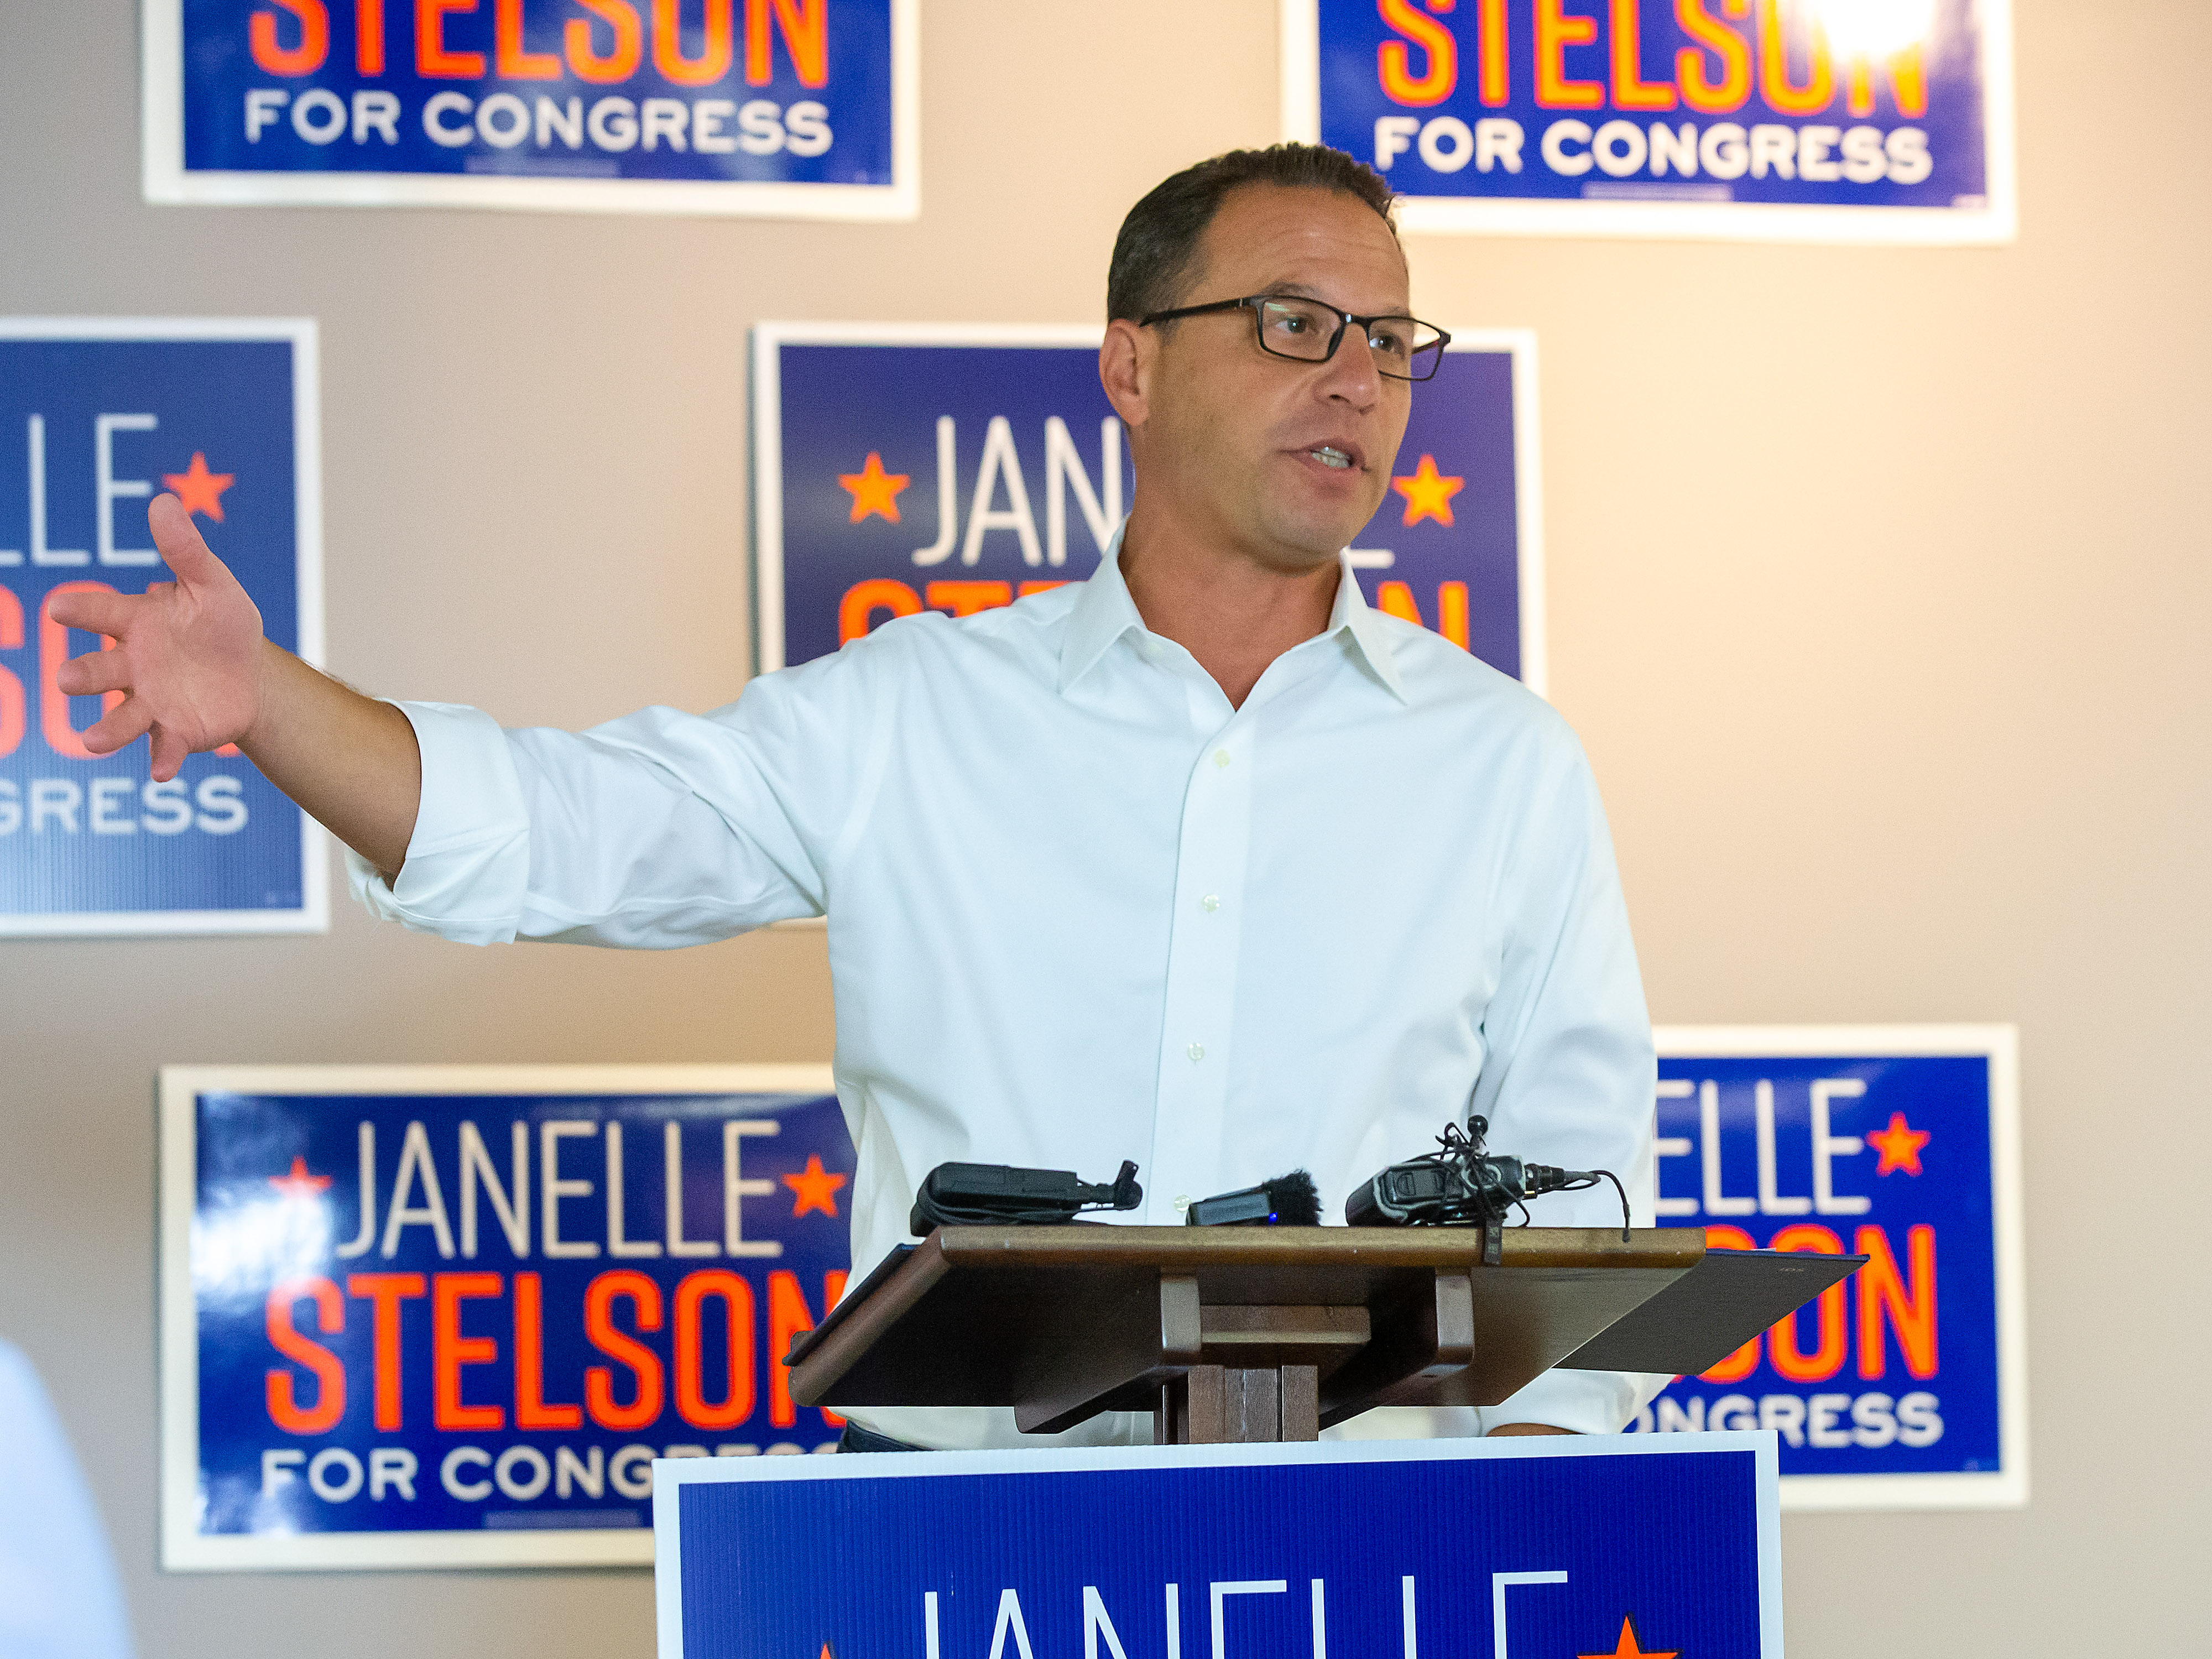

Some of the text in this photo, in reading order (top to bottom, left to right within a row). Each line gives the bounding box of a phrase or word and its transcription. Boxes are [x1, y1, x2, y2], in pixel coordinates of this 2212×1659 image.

[245, 88, 834, 157] FOR CONGRESS
[1374, 117, 1933, 184] FOR CONGRESS
[0, 414, 159, 565] LE
[336, 1120, 783, 1259] JANELLE
[262, 1443, 838, 1501] FOR CONG
